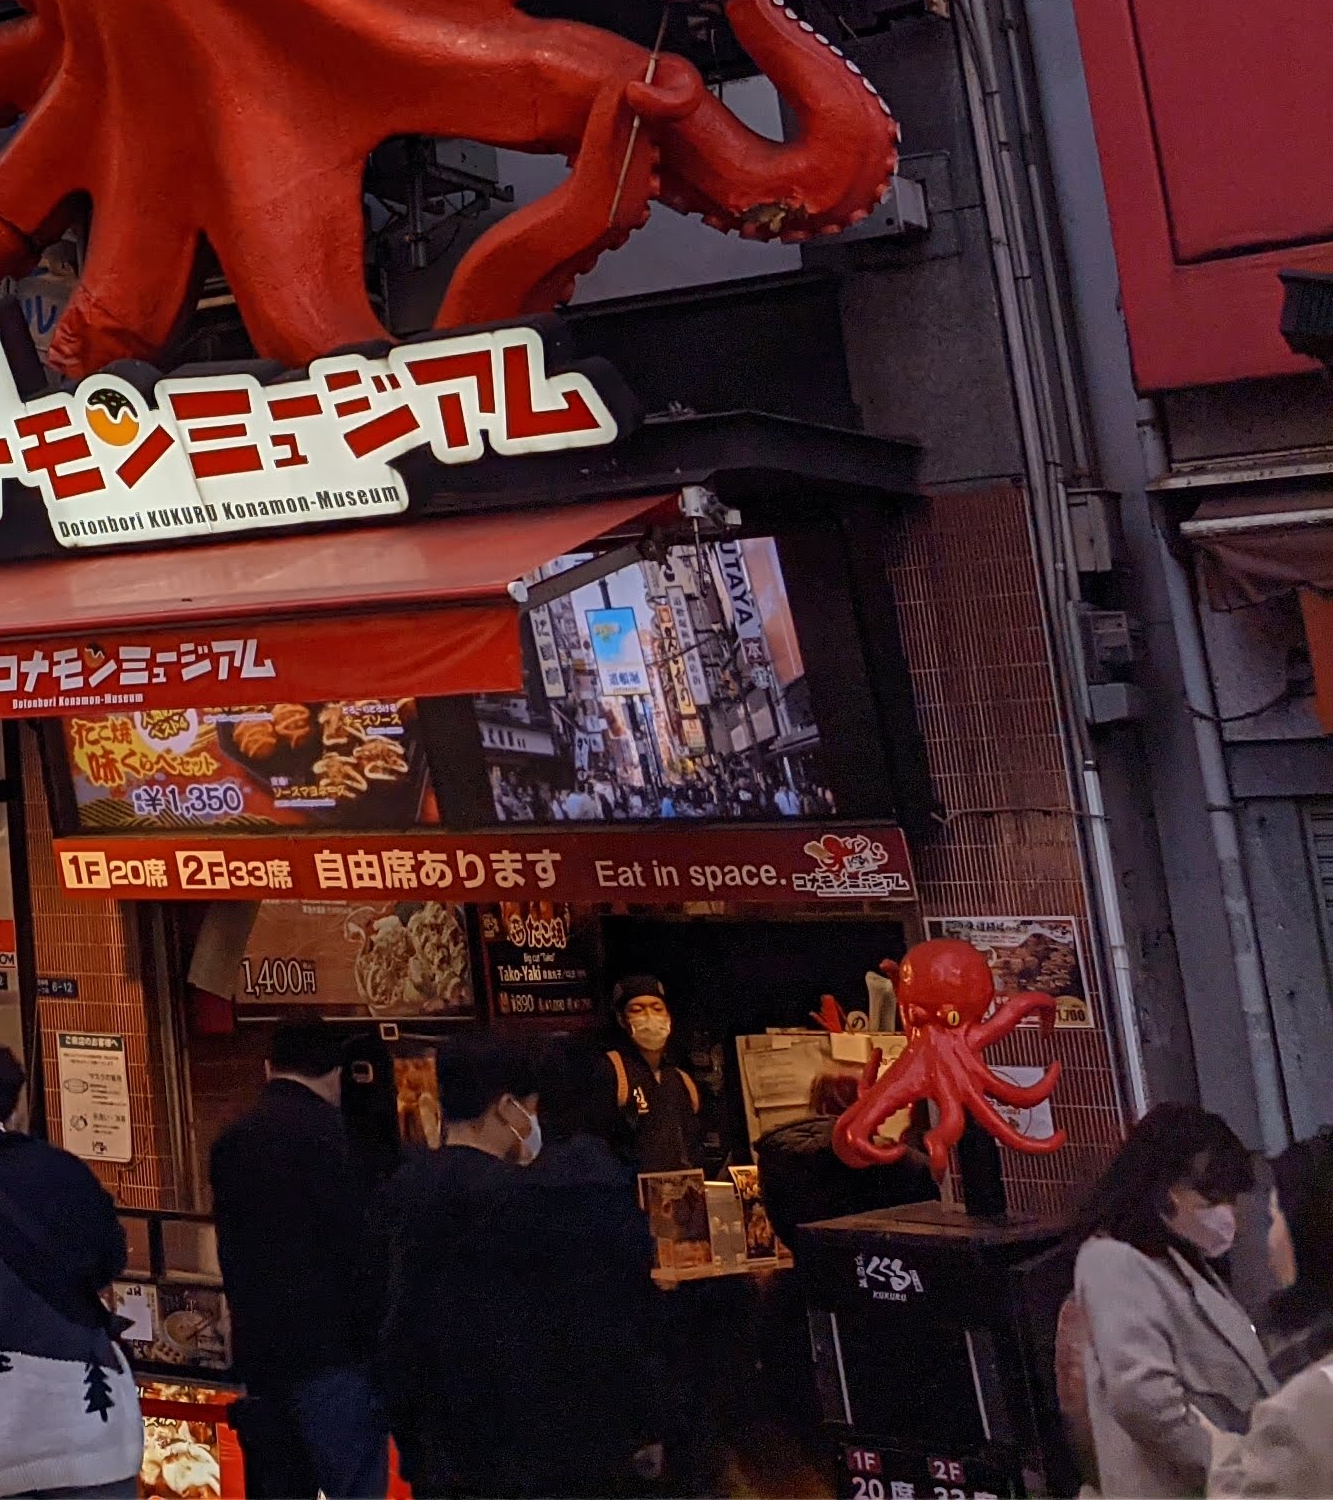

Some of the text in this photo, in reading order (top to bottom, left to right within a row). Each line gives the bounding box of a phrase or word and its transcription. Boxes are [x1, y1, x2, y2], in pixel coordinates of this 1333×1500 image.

[59, 483, 401, 540] Dotonbori KUKURU Konamon-Museum
[13, 692, 144, 710] Dotonbori Konamon-Museum
[72, 717, 133, 750] たこ焼
[87, 750, 217, 787] 味くらべセット
[142, 785, 242, 815] ¥1,350
[110, 859, 167, 888] 20席
[229, 859, 293, 889] 33席
[314, 849, 562, 890] 自由席あります
[595, 859, 787, 893] Eat in space.
[52, 982, 73, 993] 6-12
[242, 957, 316, 997] 1,400円
[498, 965, 541, 982] Tako-Yaki
[873, 1291, 907, 1301] KUKURU
[854, 1453, 960, 1480] 1F 2F
[852, 1477, 883, 1500] 20
